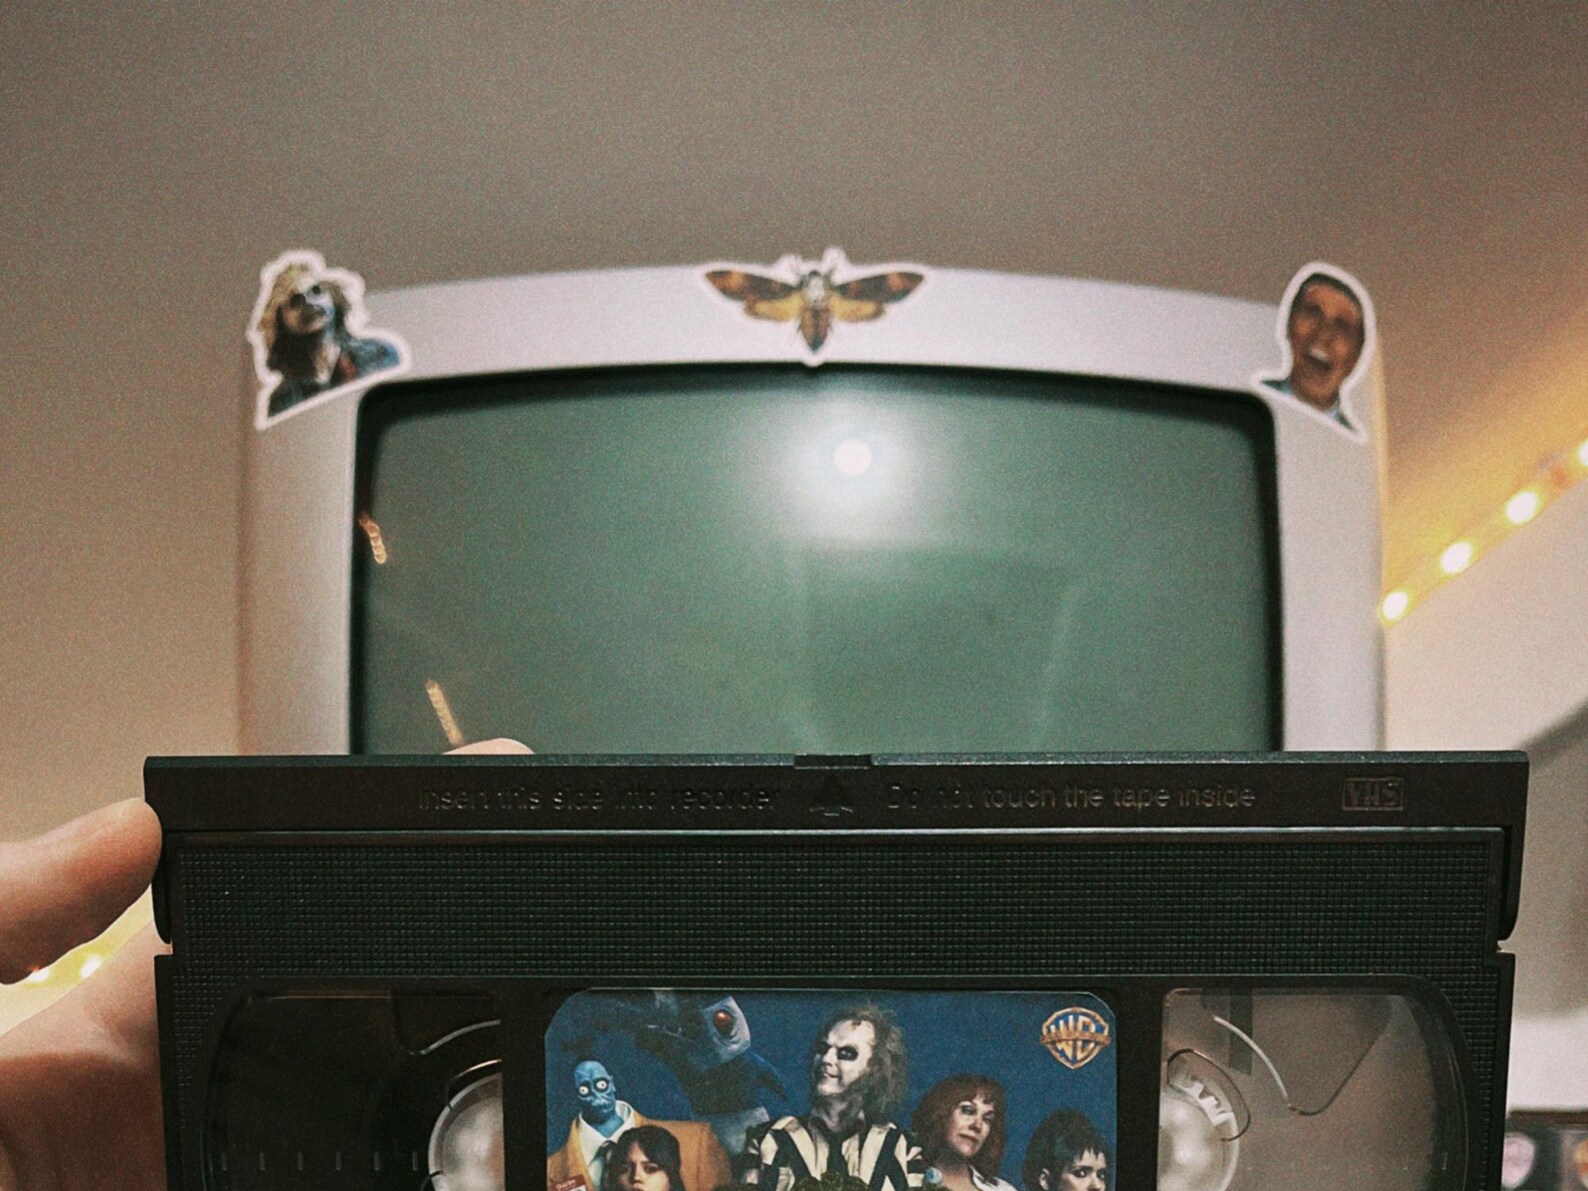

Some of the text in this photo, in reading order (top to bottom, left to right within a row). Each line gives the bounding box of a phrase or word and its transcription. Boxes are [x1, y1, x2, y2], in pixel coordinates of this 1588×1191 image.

[982, 784, 1055, 808] touch
[1062, 784, 1104, 808] the
[1113, 785, 1171, 812] tape
[1179, 784, 1256, 808] inside
